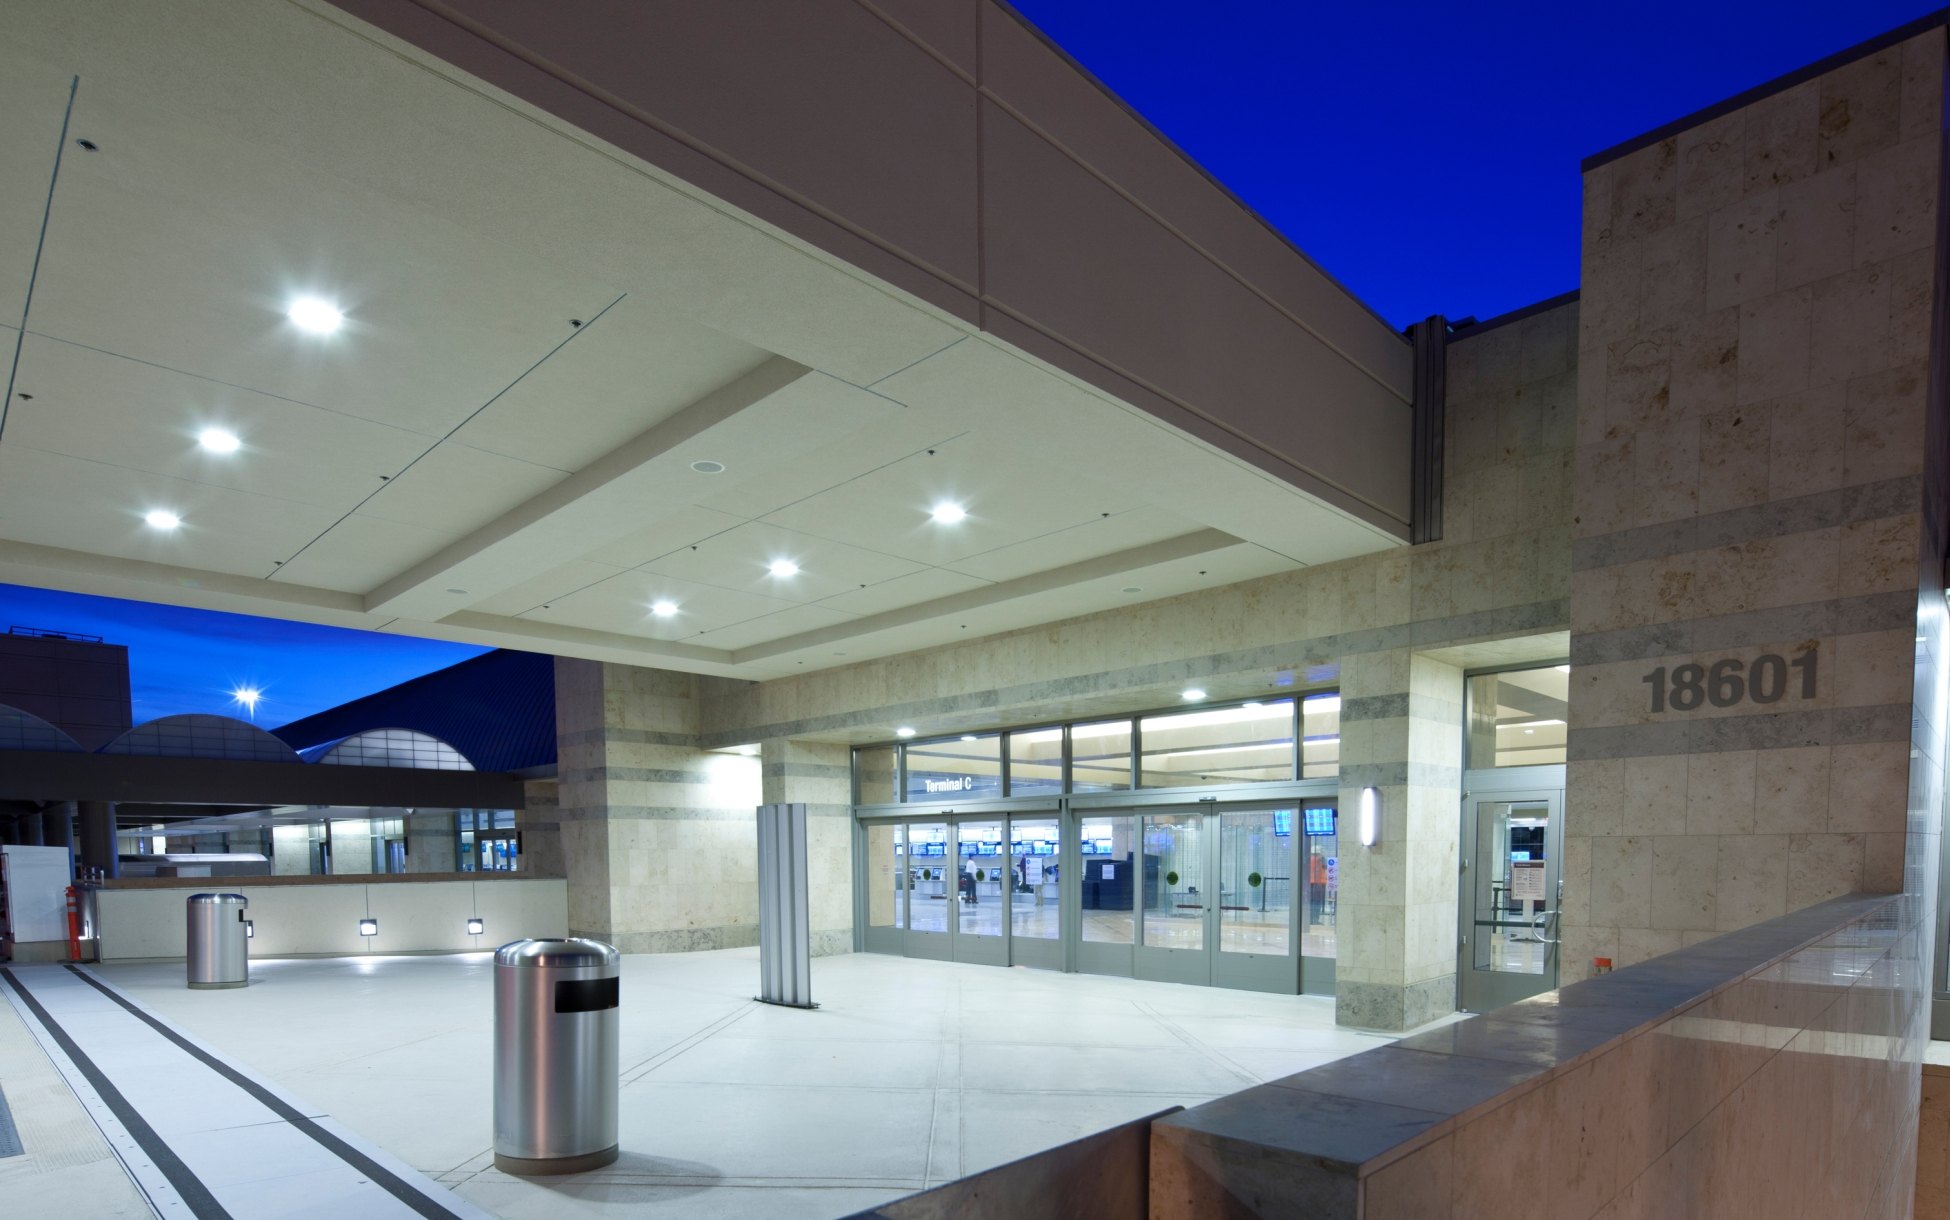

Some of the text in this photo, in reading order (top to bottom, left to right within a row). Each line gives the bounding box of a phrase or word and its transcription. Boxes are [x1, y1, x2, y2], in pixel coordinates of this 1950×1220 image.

[1642, 648, 1818, 713] 18601
[925, 776, 972, 793] Terminal C
